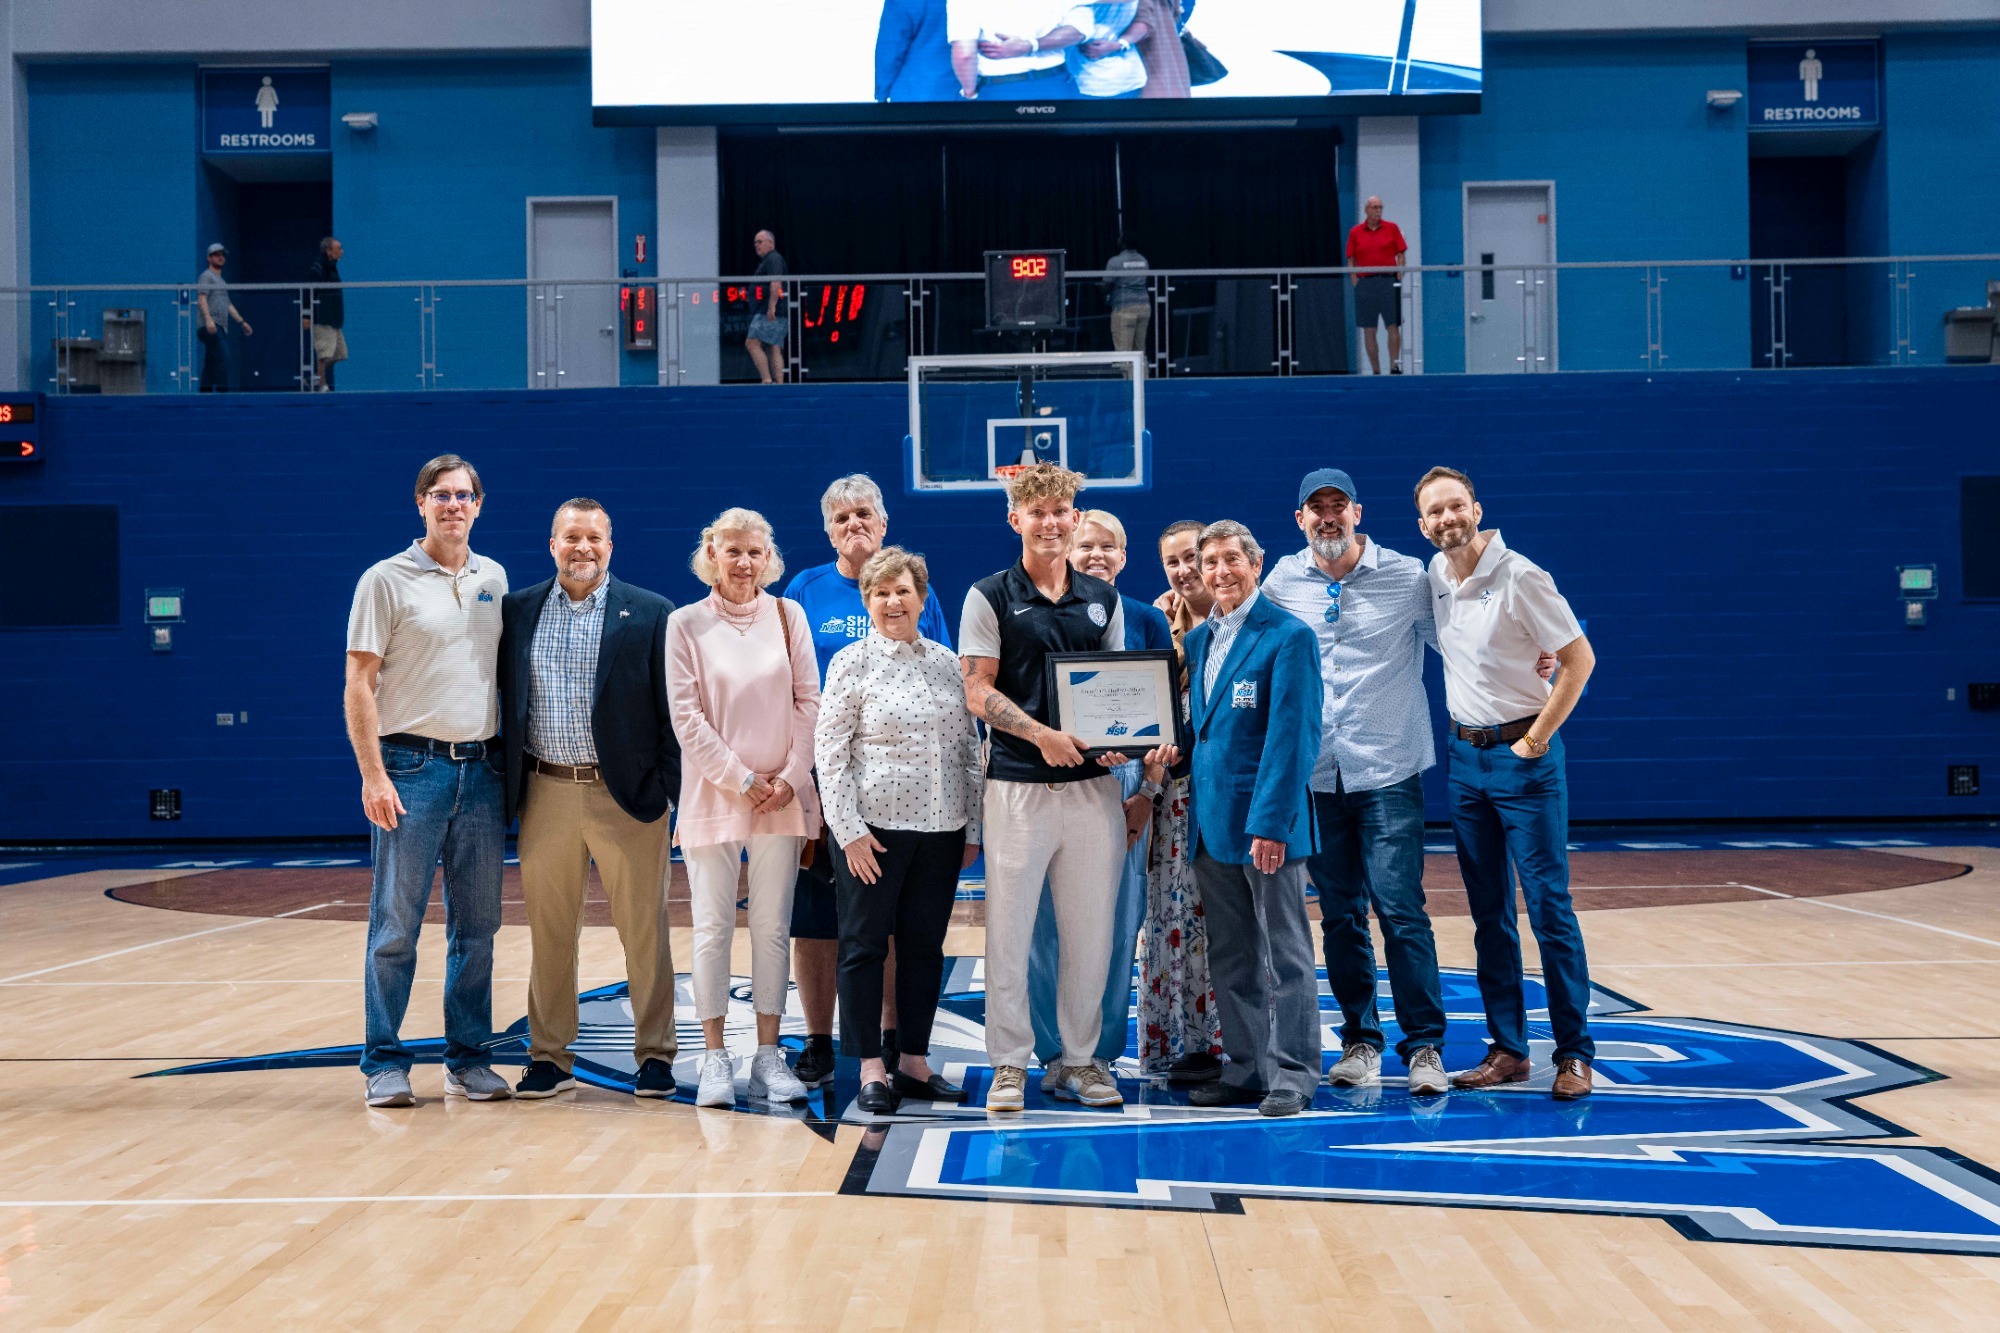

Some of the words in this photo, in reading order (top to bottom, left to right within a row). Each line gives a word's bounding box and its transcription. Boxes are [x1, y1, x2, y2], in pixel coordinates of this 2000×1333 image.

[1763, 106, 1861, 121] RESTROOMS
[220, 133, 316, 147] RESTROOMS
[1012, 257, 1047, 278] 9:02
[0, 404, 12, 422] S
[1105, 725, 1130, 737] NSU
